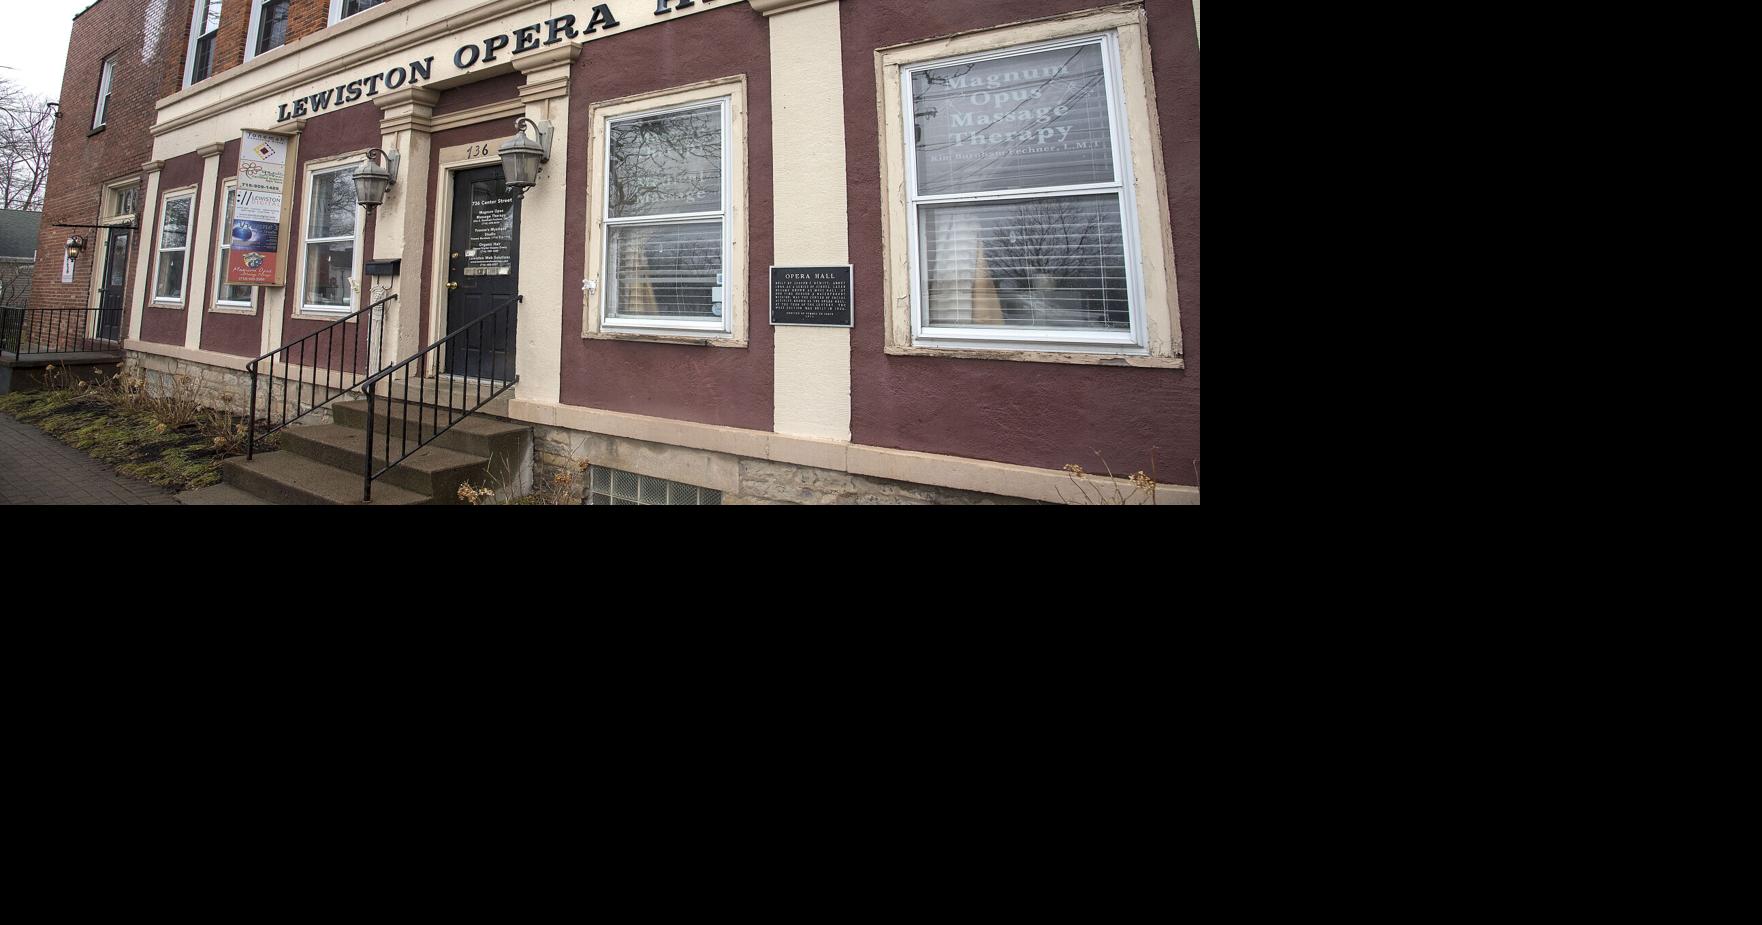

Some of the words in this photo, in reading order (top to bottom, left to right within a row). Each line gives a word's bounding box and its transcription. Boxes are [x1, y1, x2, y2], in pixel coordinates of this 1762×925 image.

[277, 56, 434, 123] LEWISTON
[453, 3, 620, 69] OPERA
[945, 64, 1069, 89] Magnum
[970, 87, 1042, 108] Opus
[951, 103, 1069, 127] Massage
[952, 124, 1073, 147] Therapy
[251, 194, 281, 203] LEWISTON
